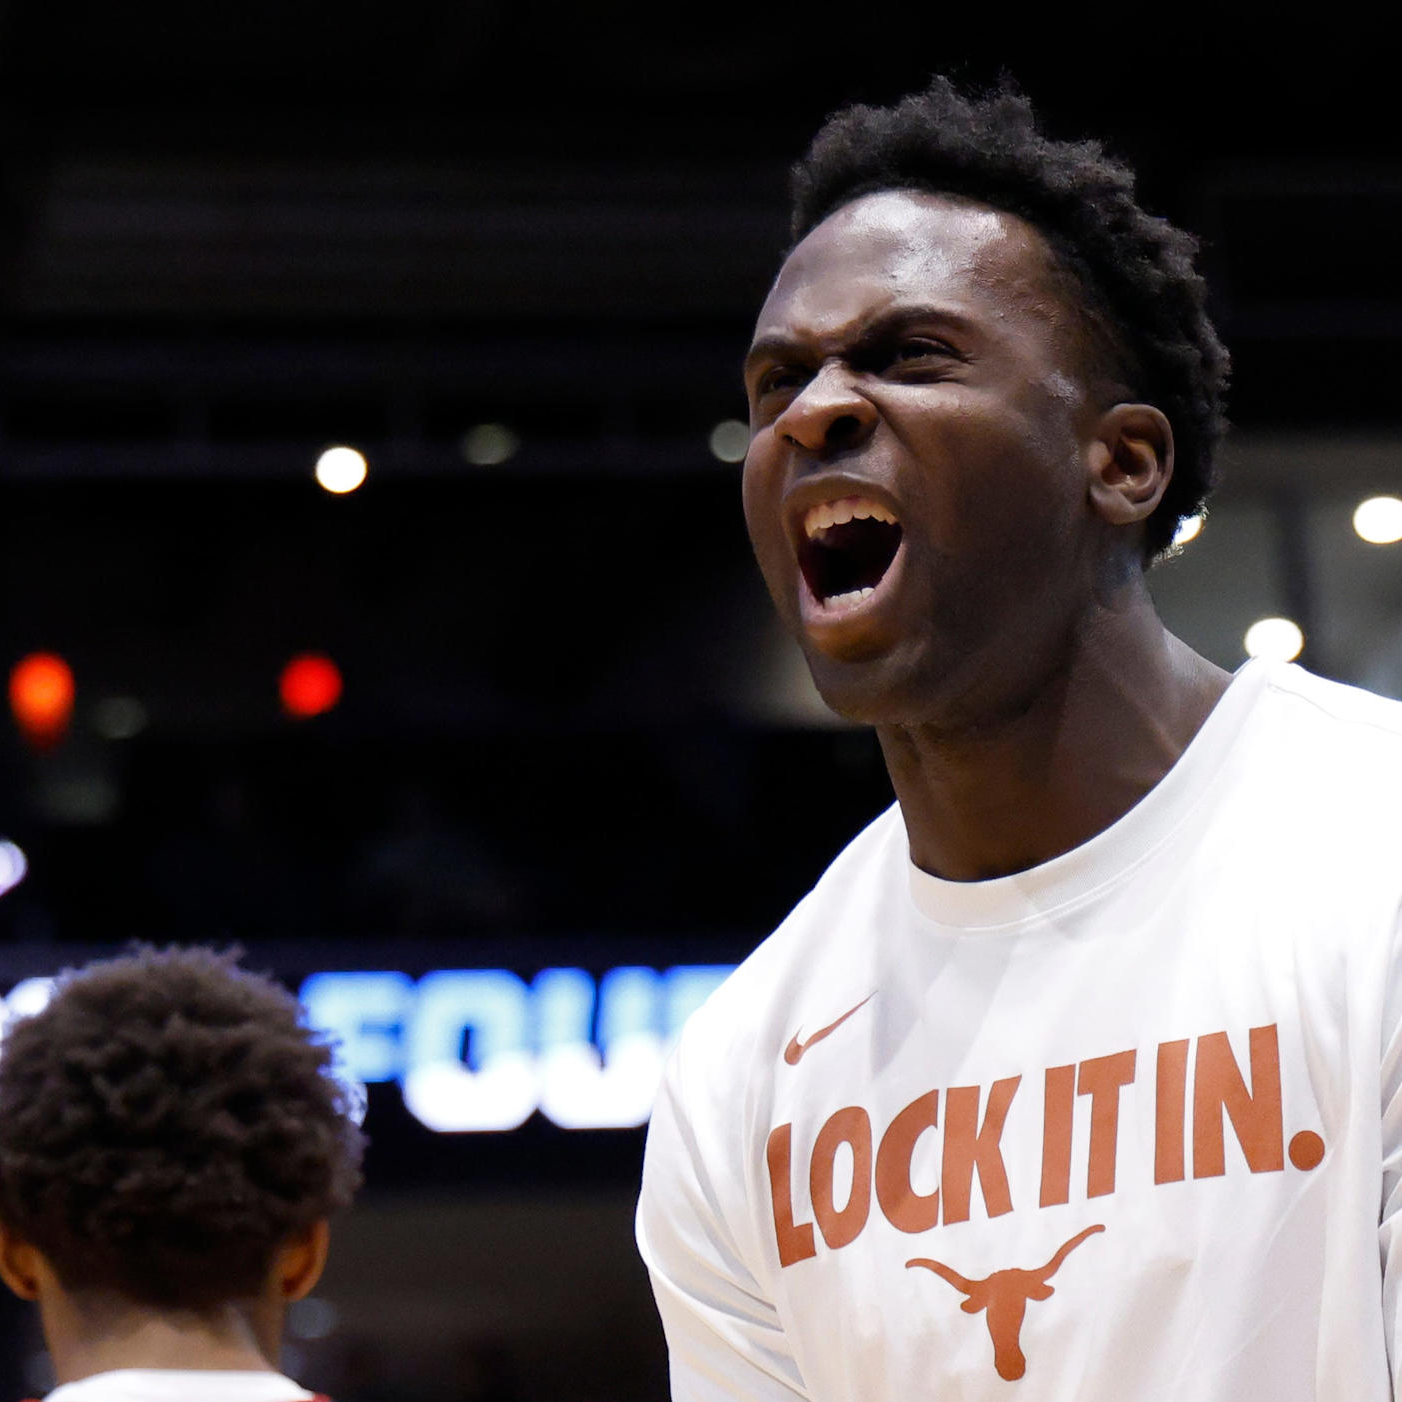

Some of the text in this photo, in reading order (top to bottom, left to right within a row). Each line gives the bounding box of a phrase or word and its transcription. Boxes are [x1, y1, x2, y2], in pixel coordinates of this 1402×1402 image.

[298, 963, 746, 1133] FOU
[766, 1022, 1326, 1268] LOCK IT IN.
